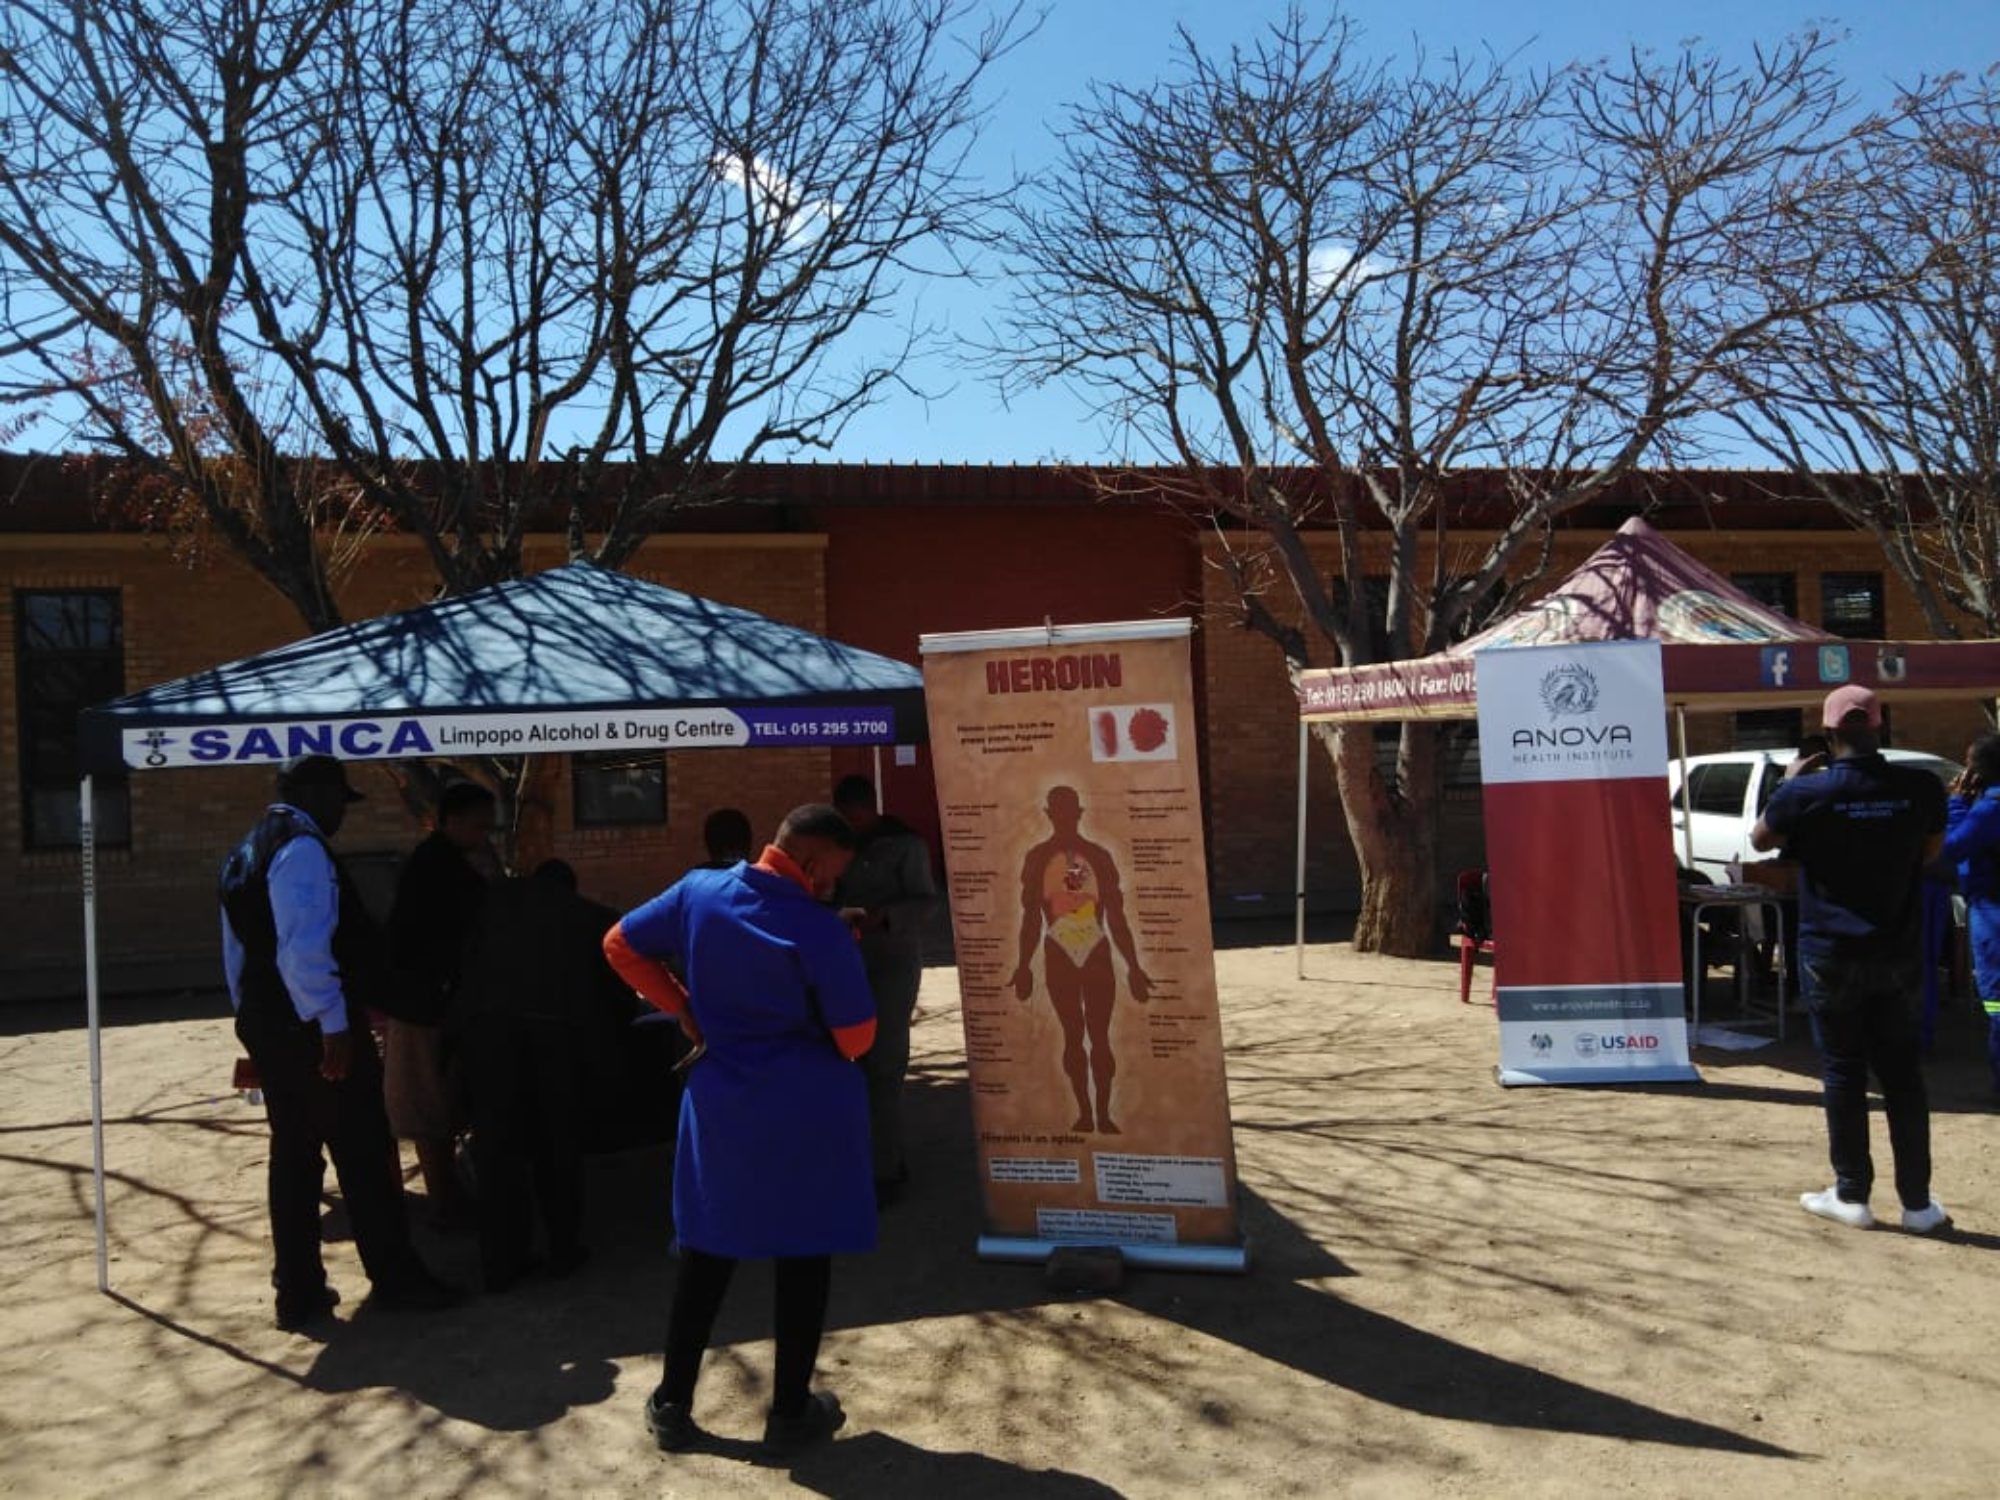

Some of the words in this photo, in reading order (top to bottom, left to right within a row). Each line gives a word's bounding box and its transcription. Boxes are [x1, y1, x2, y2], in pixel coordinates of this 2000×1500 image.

[986, 653, 1122, 694] HEROIN
[1420, 675, 1448, 696] Fax:
[440, 726, 524, 747] Limpopo
[528, 723, 600, 741] Alcohol
[605, 722, 618, 739] &
[625, 721, 669, 743] Drug
[674, 719, 735, 738] Centre
[753, 722, 786, 736] TEL:
[791, 722, 818, 735] 015
[822, 721, 849, 735] 295
[852, 720, 888, 734] 3700
[1513, 725, 1632, 748] ANOVA
[188, 720, 436, 761] SANCA
[1513, 752, 1560, 763] HEALTH
[1566, 749, 1633, 761] INSTITUTE
[1601, 1035, 1659, 1050] USAID
